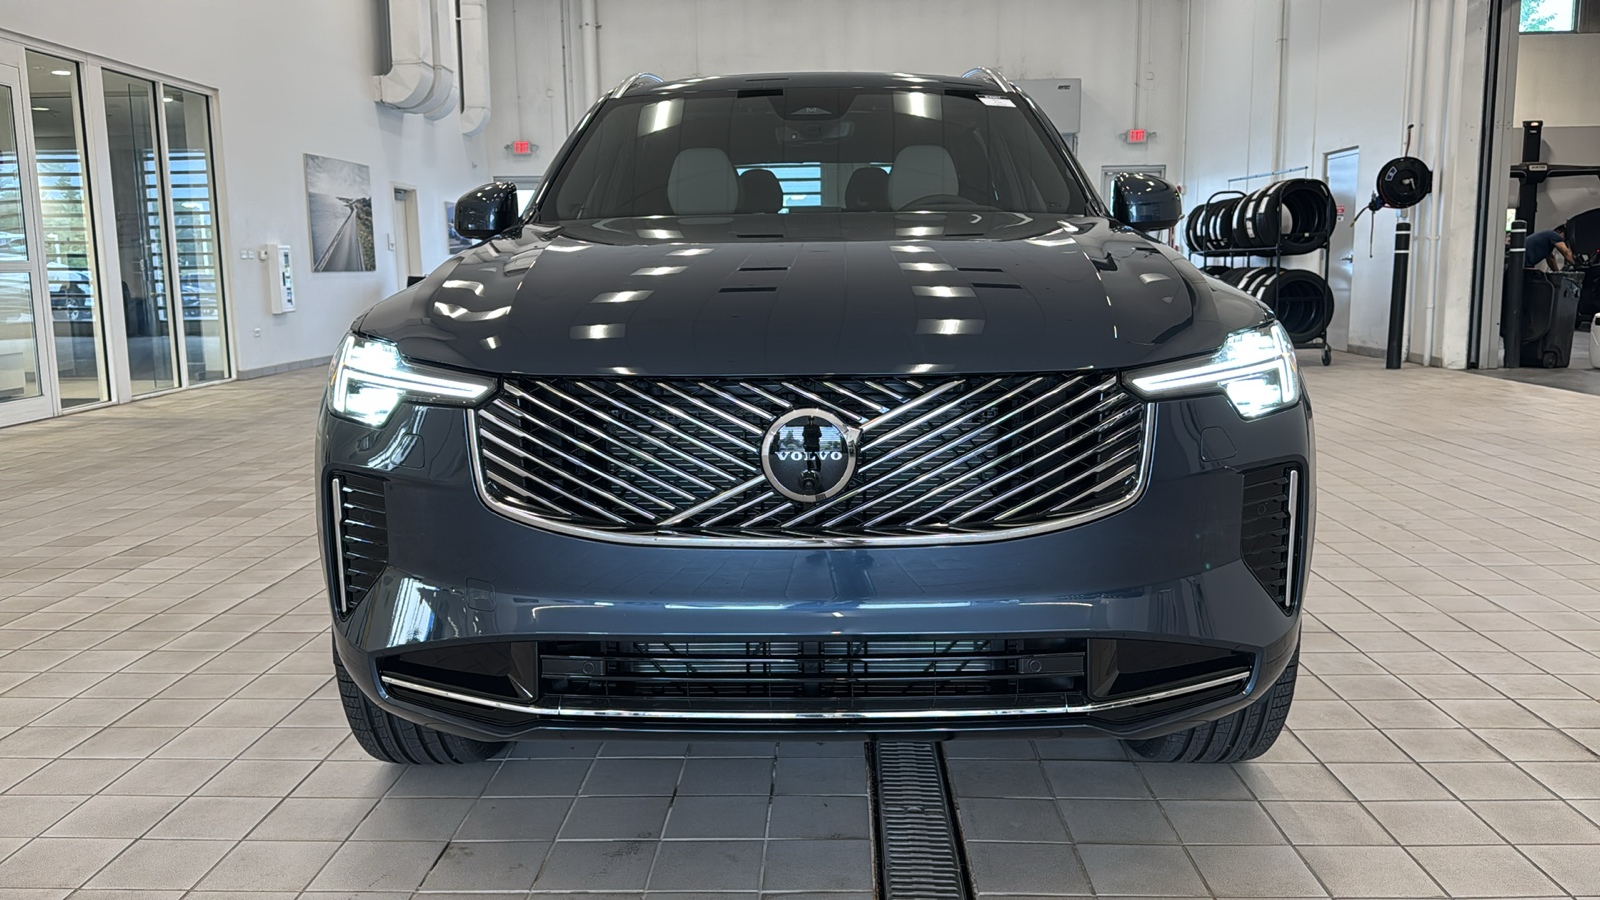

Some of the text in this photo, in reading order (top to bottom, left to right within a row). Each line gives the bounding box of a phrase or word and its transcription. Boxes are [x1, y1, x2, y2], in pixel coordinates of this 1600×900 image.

[1130, 129, 1145, 142] EXIT
[514, 141, 529, 153] EXIT
[775, 451, 842, 461] VOLVO
